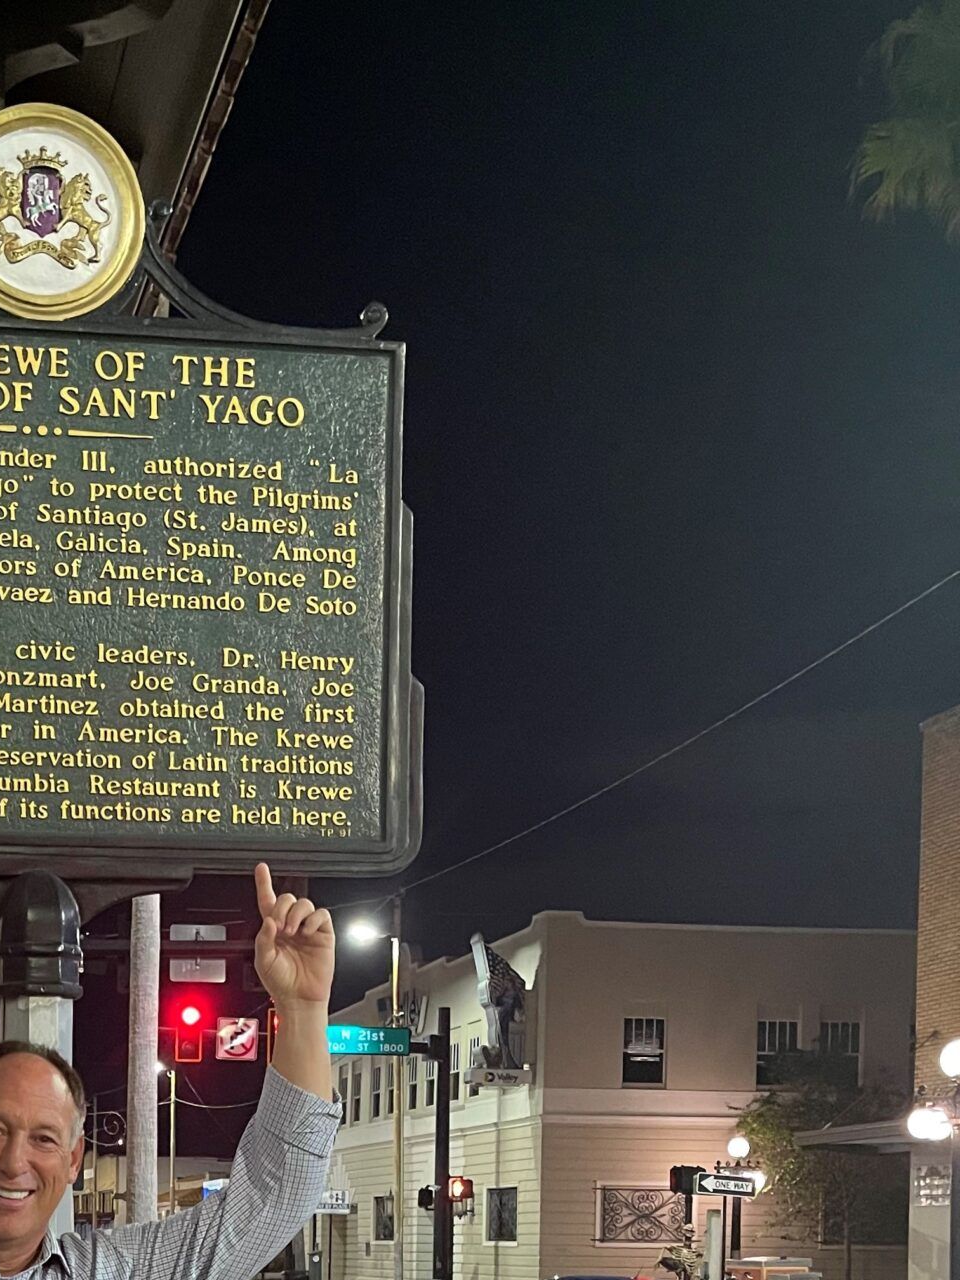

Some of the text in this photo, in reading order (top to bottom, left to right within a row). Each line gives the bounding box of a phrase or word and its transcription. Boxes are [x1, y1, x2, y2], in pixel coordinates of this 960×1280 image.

[94, 349, 146, 382] OF
[171, 354, 256, 388] THE
[58, 385, 176, 420] SANT'
[198, 393, 305, 427] YAGO
[143, 455, 283, 481] authorized
[48, 476, 75, 497] to
[89, 477, 183, 502] protect
[196, 483, 238, 505] the
[251, 483, 359, 514] Pilgrims'
[36, 502, 147, 533] Santiago
[163, 509, 206, 531] (St.
[220, 511, 315, 538] James),
[333, 518, 358, 537] at
[55, 528, 148, 556] Galicia,
[166, 533, 243, 561] Spain.
[271, 539, 357, 569] Among
[53, 555, 82, 578] of
[99, 558, 212, 586] America,
[232, 564, 307, 588] Ponce
[322, 567, 357, 590] De
[67, 585, 112, 606] and
[126, 585, 245, 611] Hernando
[258, 587, 292, 614] De
[305, 594, 357, 617] Soto
[14, 639, 76, 662] civic
[97, 642, 196, 667] leaders,
[222, 646, 259, 668] Dr.
[280, 648, 355, 676] Henry
[129, 669, 175, 692] Joe
[191, 672, 287, 697] Granda,
[310, 676, 355, 703] Joe
[119, 696, 225, 720] obtained
[244, 700, 285, 722] the
[303, 701, 355, 726] first
[33, 719, 56, 740] in
[77, 718, 189, 745] America.
[210, 725, 259, 747] The
[276, 727, 354, 750] Krewe
[131, 750, 161, 770] of
[167, 746, 231, 772] Latin
[239, 751, 354, 778] traditions
[89, 773, 221, 798] Restaurant
[238, 777, 257, 799] is
[277, 774, 353, 801] Krewe
[19, 796, 48, 819] its
[59, 798, 173, 822] functions
[180, 807, 221, 824] are
[231, 803, 284, 825] held
[291, 806, 350, 826] here.
[341, 1029, 385, 1041] N 21st
[357, 1042, 369, 1052] ST
[380, 1043, 404, 1052] 1800
[714, 1180, 750, 1191] ONE WAY
